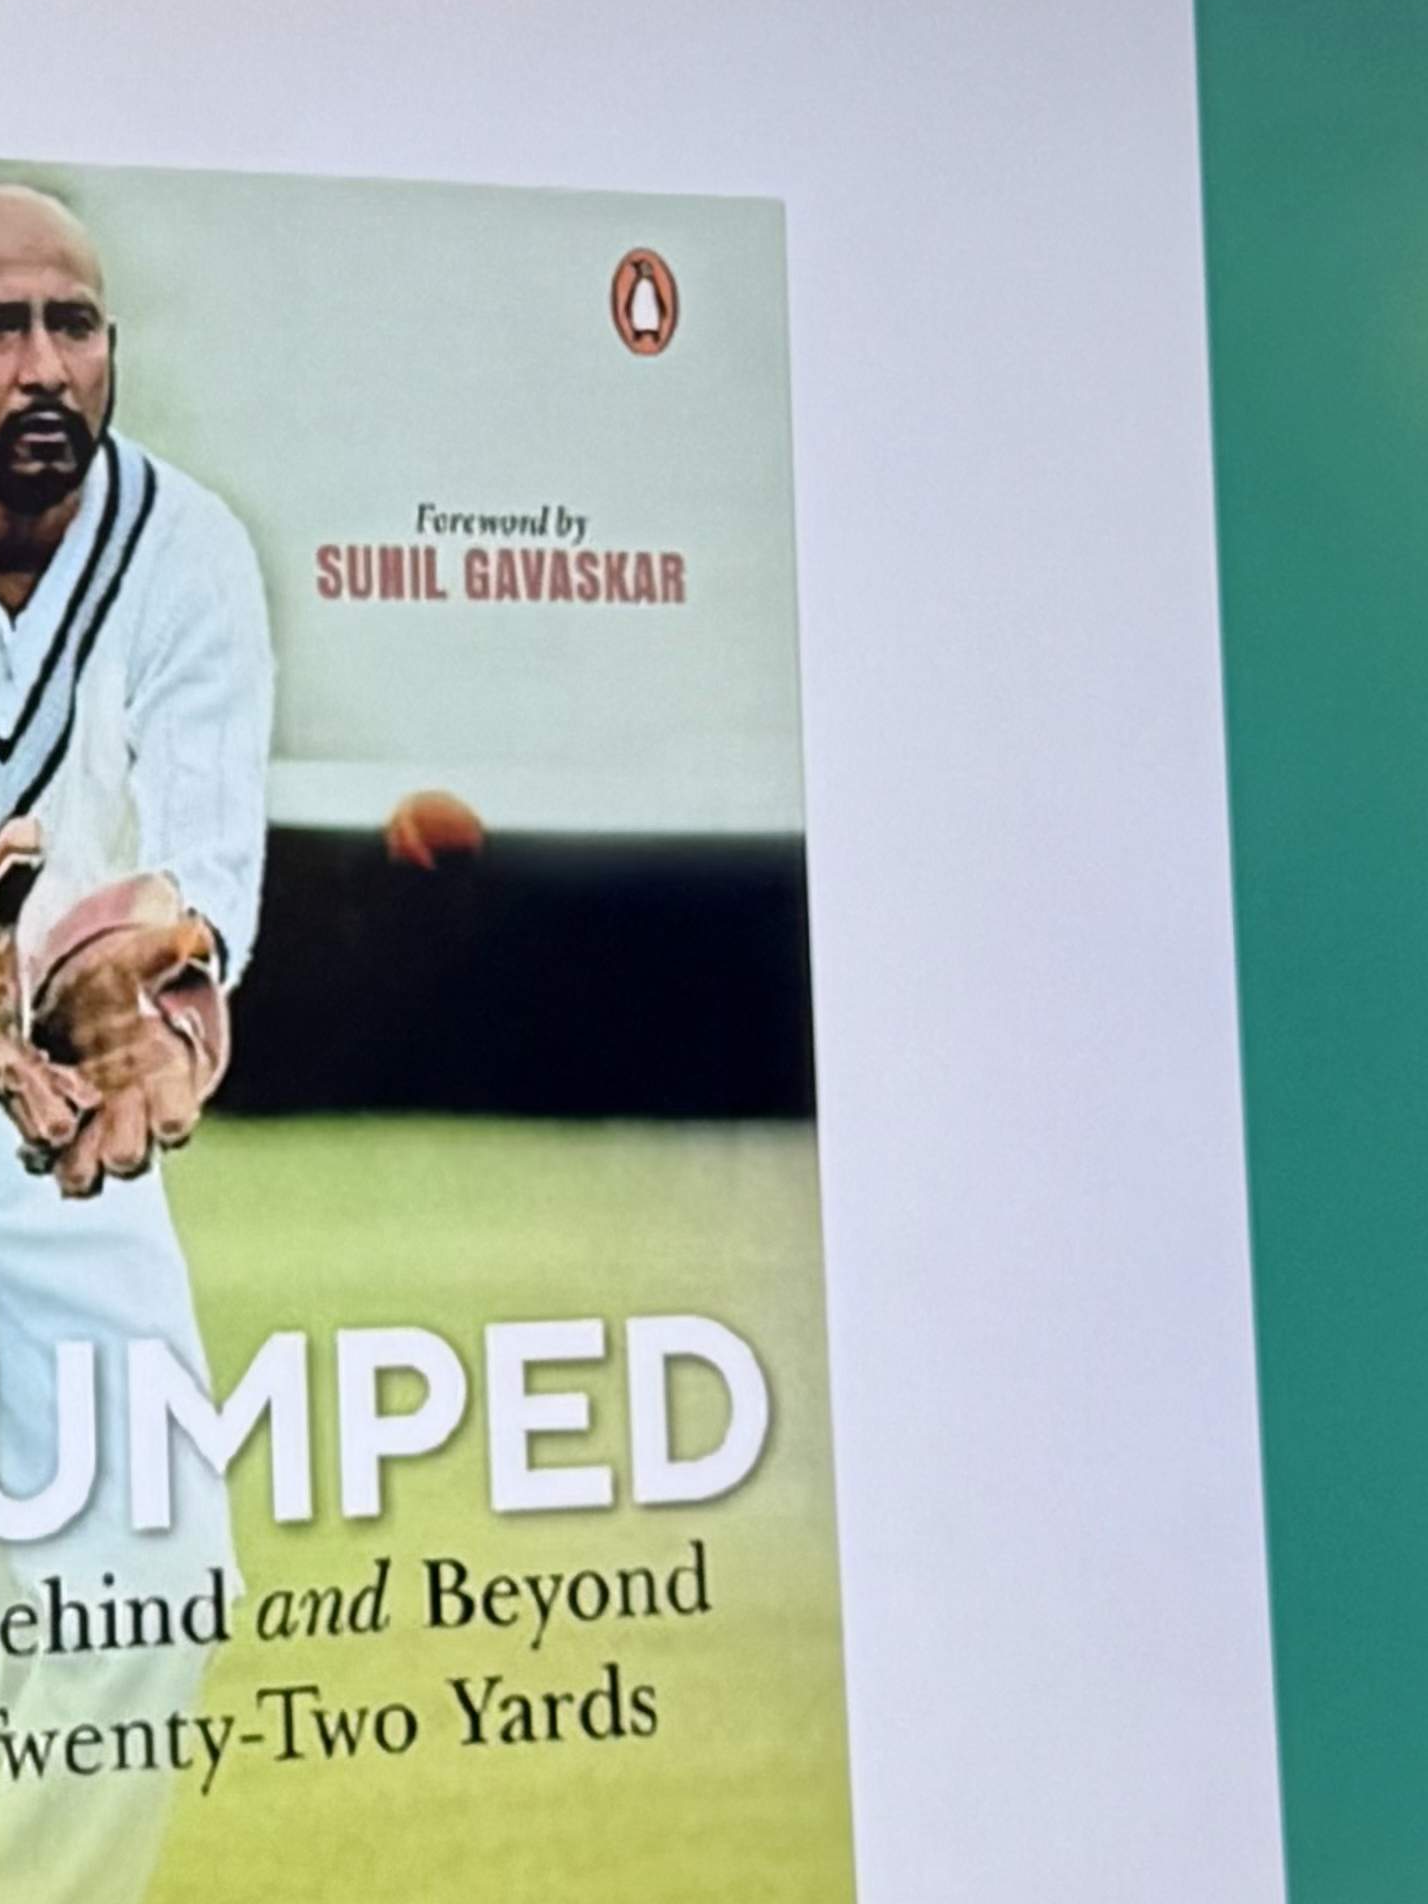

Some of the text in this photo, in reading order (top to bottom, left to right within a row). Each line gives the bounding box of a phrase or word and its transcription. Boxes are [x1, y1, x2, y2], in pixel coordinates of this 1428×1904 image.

[416, 502, 588, 546] Foreword by
[316, 543, 687, 604] SUNIL GAVASKAR
[256, 1559, 394, 1643] and
[422, 1541, 713, 1649] Beyond
[449, 1663, 659, 1747] Yards
